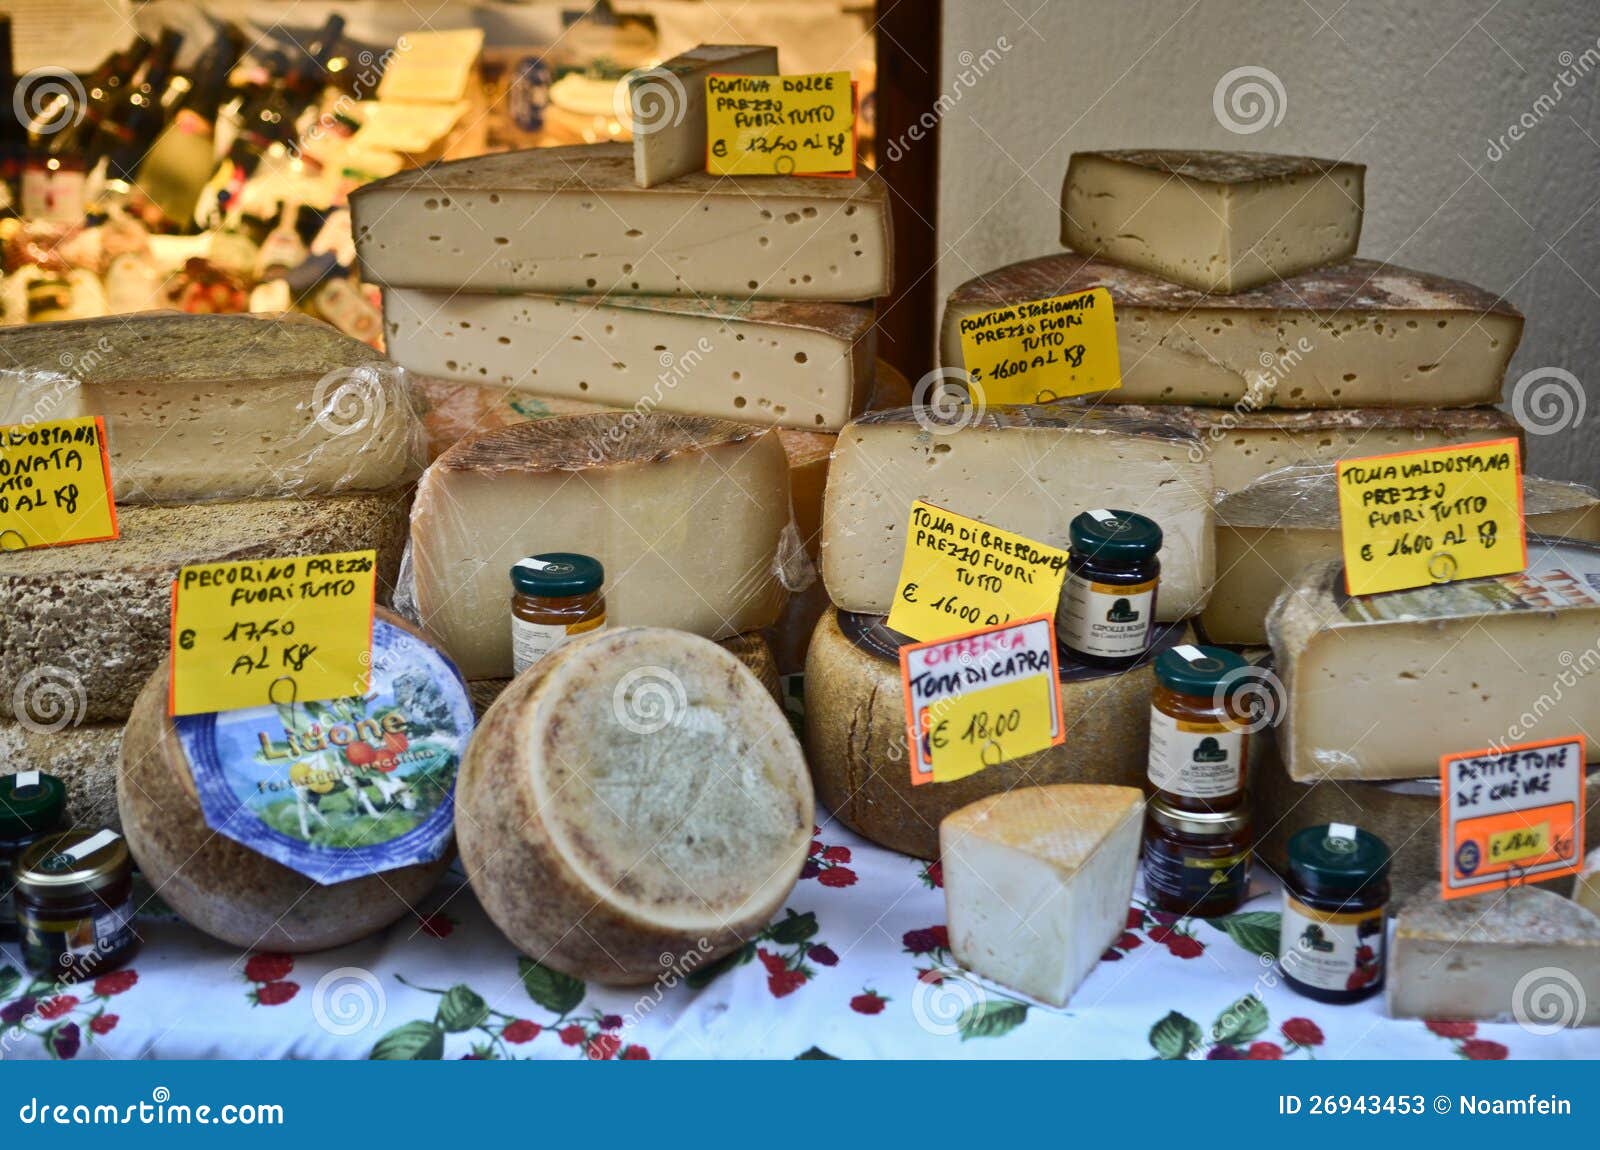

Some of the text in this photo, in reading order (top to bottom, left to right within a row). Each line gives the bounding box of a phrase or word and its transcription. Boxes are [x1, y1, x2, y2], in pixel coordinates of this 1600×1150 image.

[788, 104, 835, 125] TUTTO
[975, 323, 1035, 345] PREZZO
[1021, 332, 1064, 352] TUTTO
[1031, 350, 1058, 369] AL
[1401, 453, 1510, 478] VALDOSTANA
[16, 489, 47, 511] AL
[1430, 496, 1488, 522] TUTTO
[913, 507, 955, 535] TOMA
[1443, 524, 1467, 545] AL
[916, 530, 980, 566] PREZZO
[300, 580, 355, 599] TUTTO
[956, 567, 1003, 593] TUTTO
[902, 582, 918, 603] €
[231, 646, 269, 675] AL
[965, 666, 988, 685] DI
[991, 650, 1050, 677] CAPRA
[932, 720, 950, 748] €
